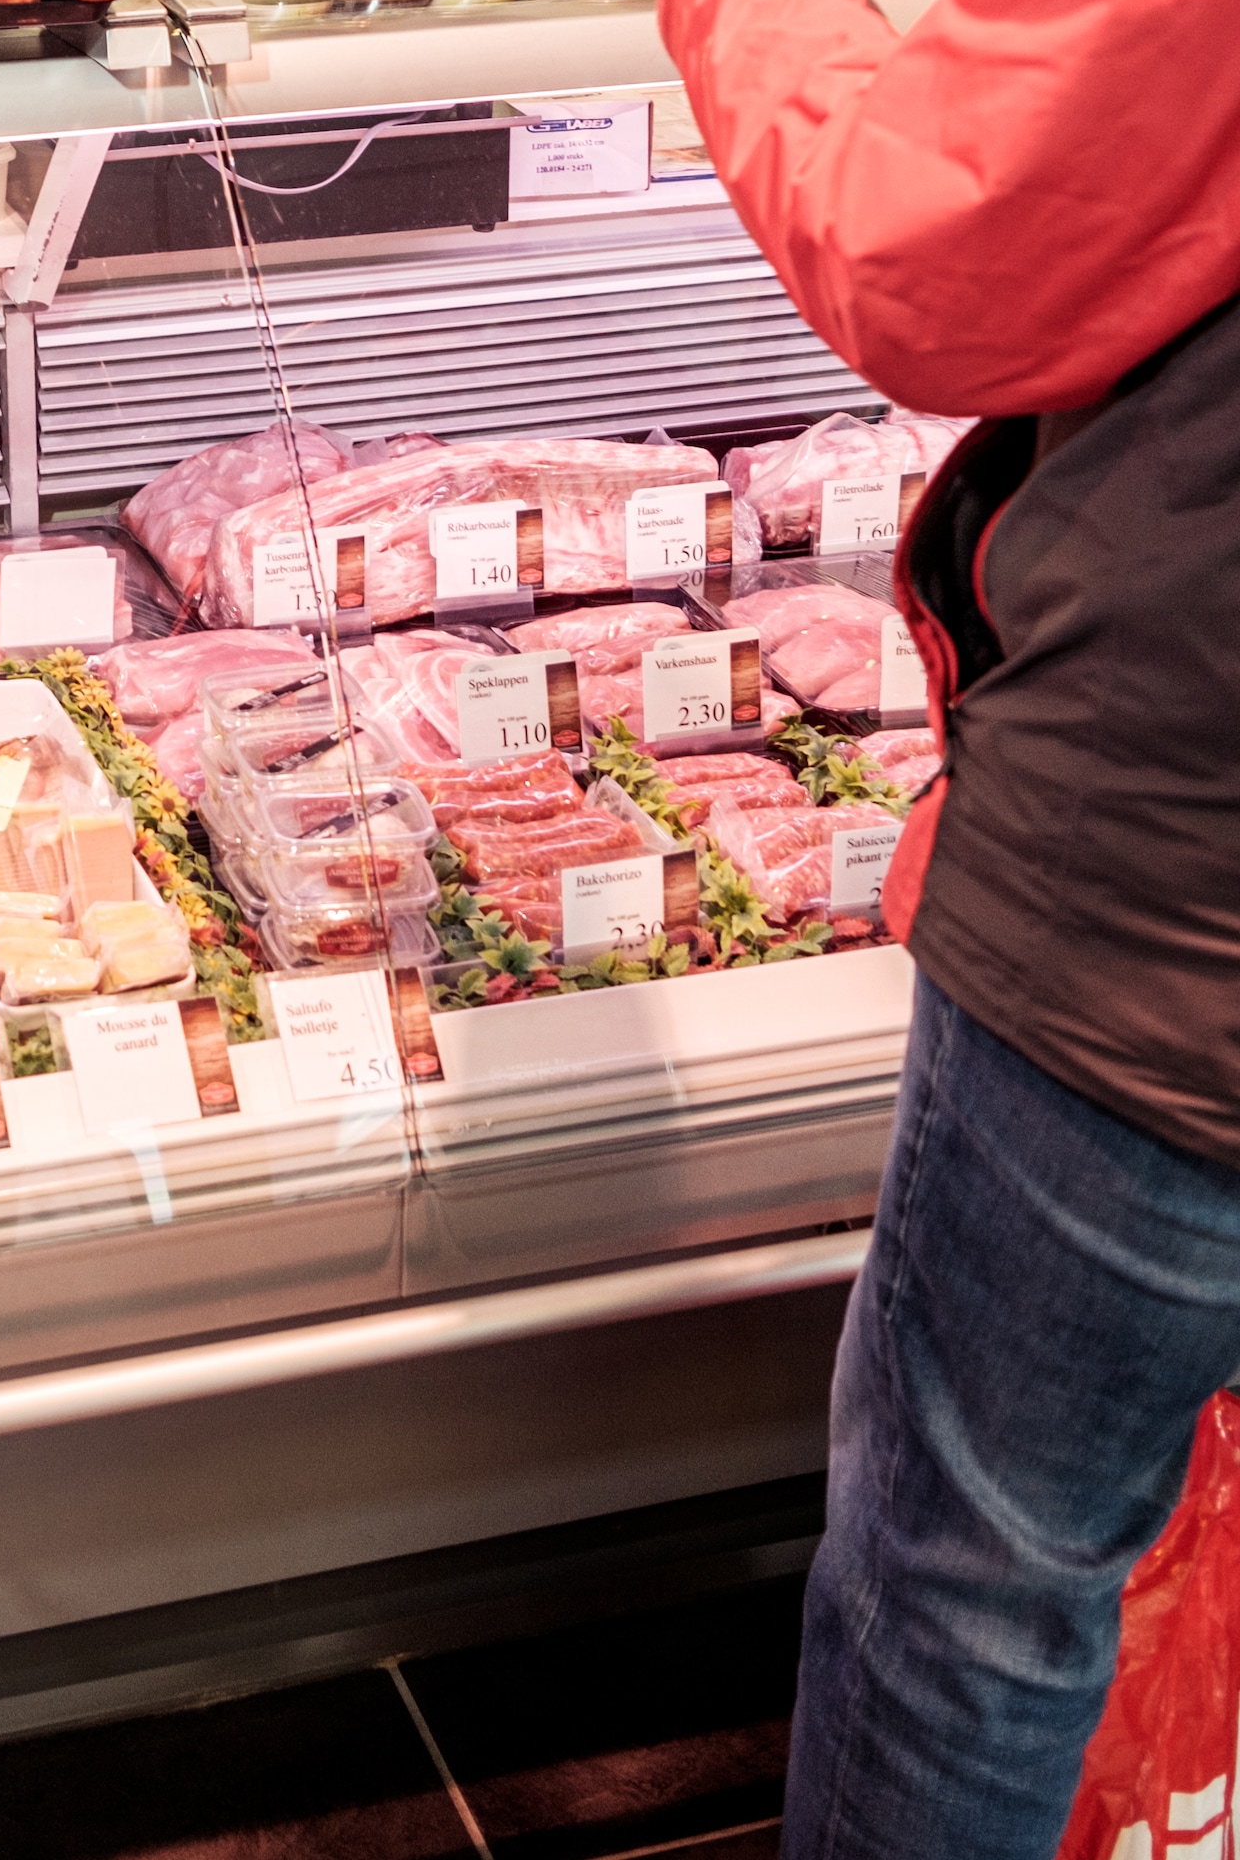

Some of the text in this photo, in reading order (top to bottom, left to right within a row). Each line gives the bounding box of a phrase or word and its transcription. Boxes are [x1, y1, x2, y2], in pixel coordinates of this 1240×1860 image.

[834, 482, 885, 495] Filetrollade
[637, 506, 664, 516] Haas-
[447, 519, 511, 532] Ribkarbonade
[637, 516, 685, 529] karbonade
[856, 522, 894, 546] 1,60
[664, 544, 704, 567] 1,50
[472, 564, 512, 587] 1,40
[655, 655, 717, 670] Varkenshaas
[468, 676, 529, 691] Speklappen
[678, 701, 725, 728] 2,30
[502, 722, 547, 750] 1,10
[847, 833, 896, 849] Salsiccia
[846, 853, 882, 868] pikant
[576, 869, 642, 888] Bakchorizo
[611, 920, 665, 952] 2,30
[285, 999, 332, 1017] Saltufo
[96, 1013, 168, 1034] Mousse du
[290, 1018, 339, 1037] bolletje
[114, 1034, 158, 1052] canard
[340, 1055, 394, 1089] 4,50
